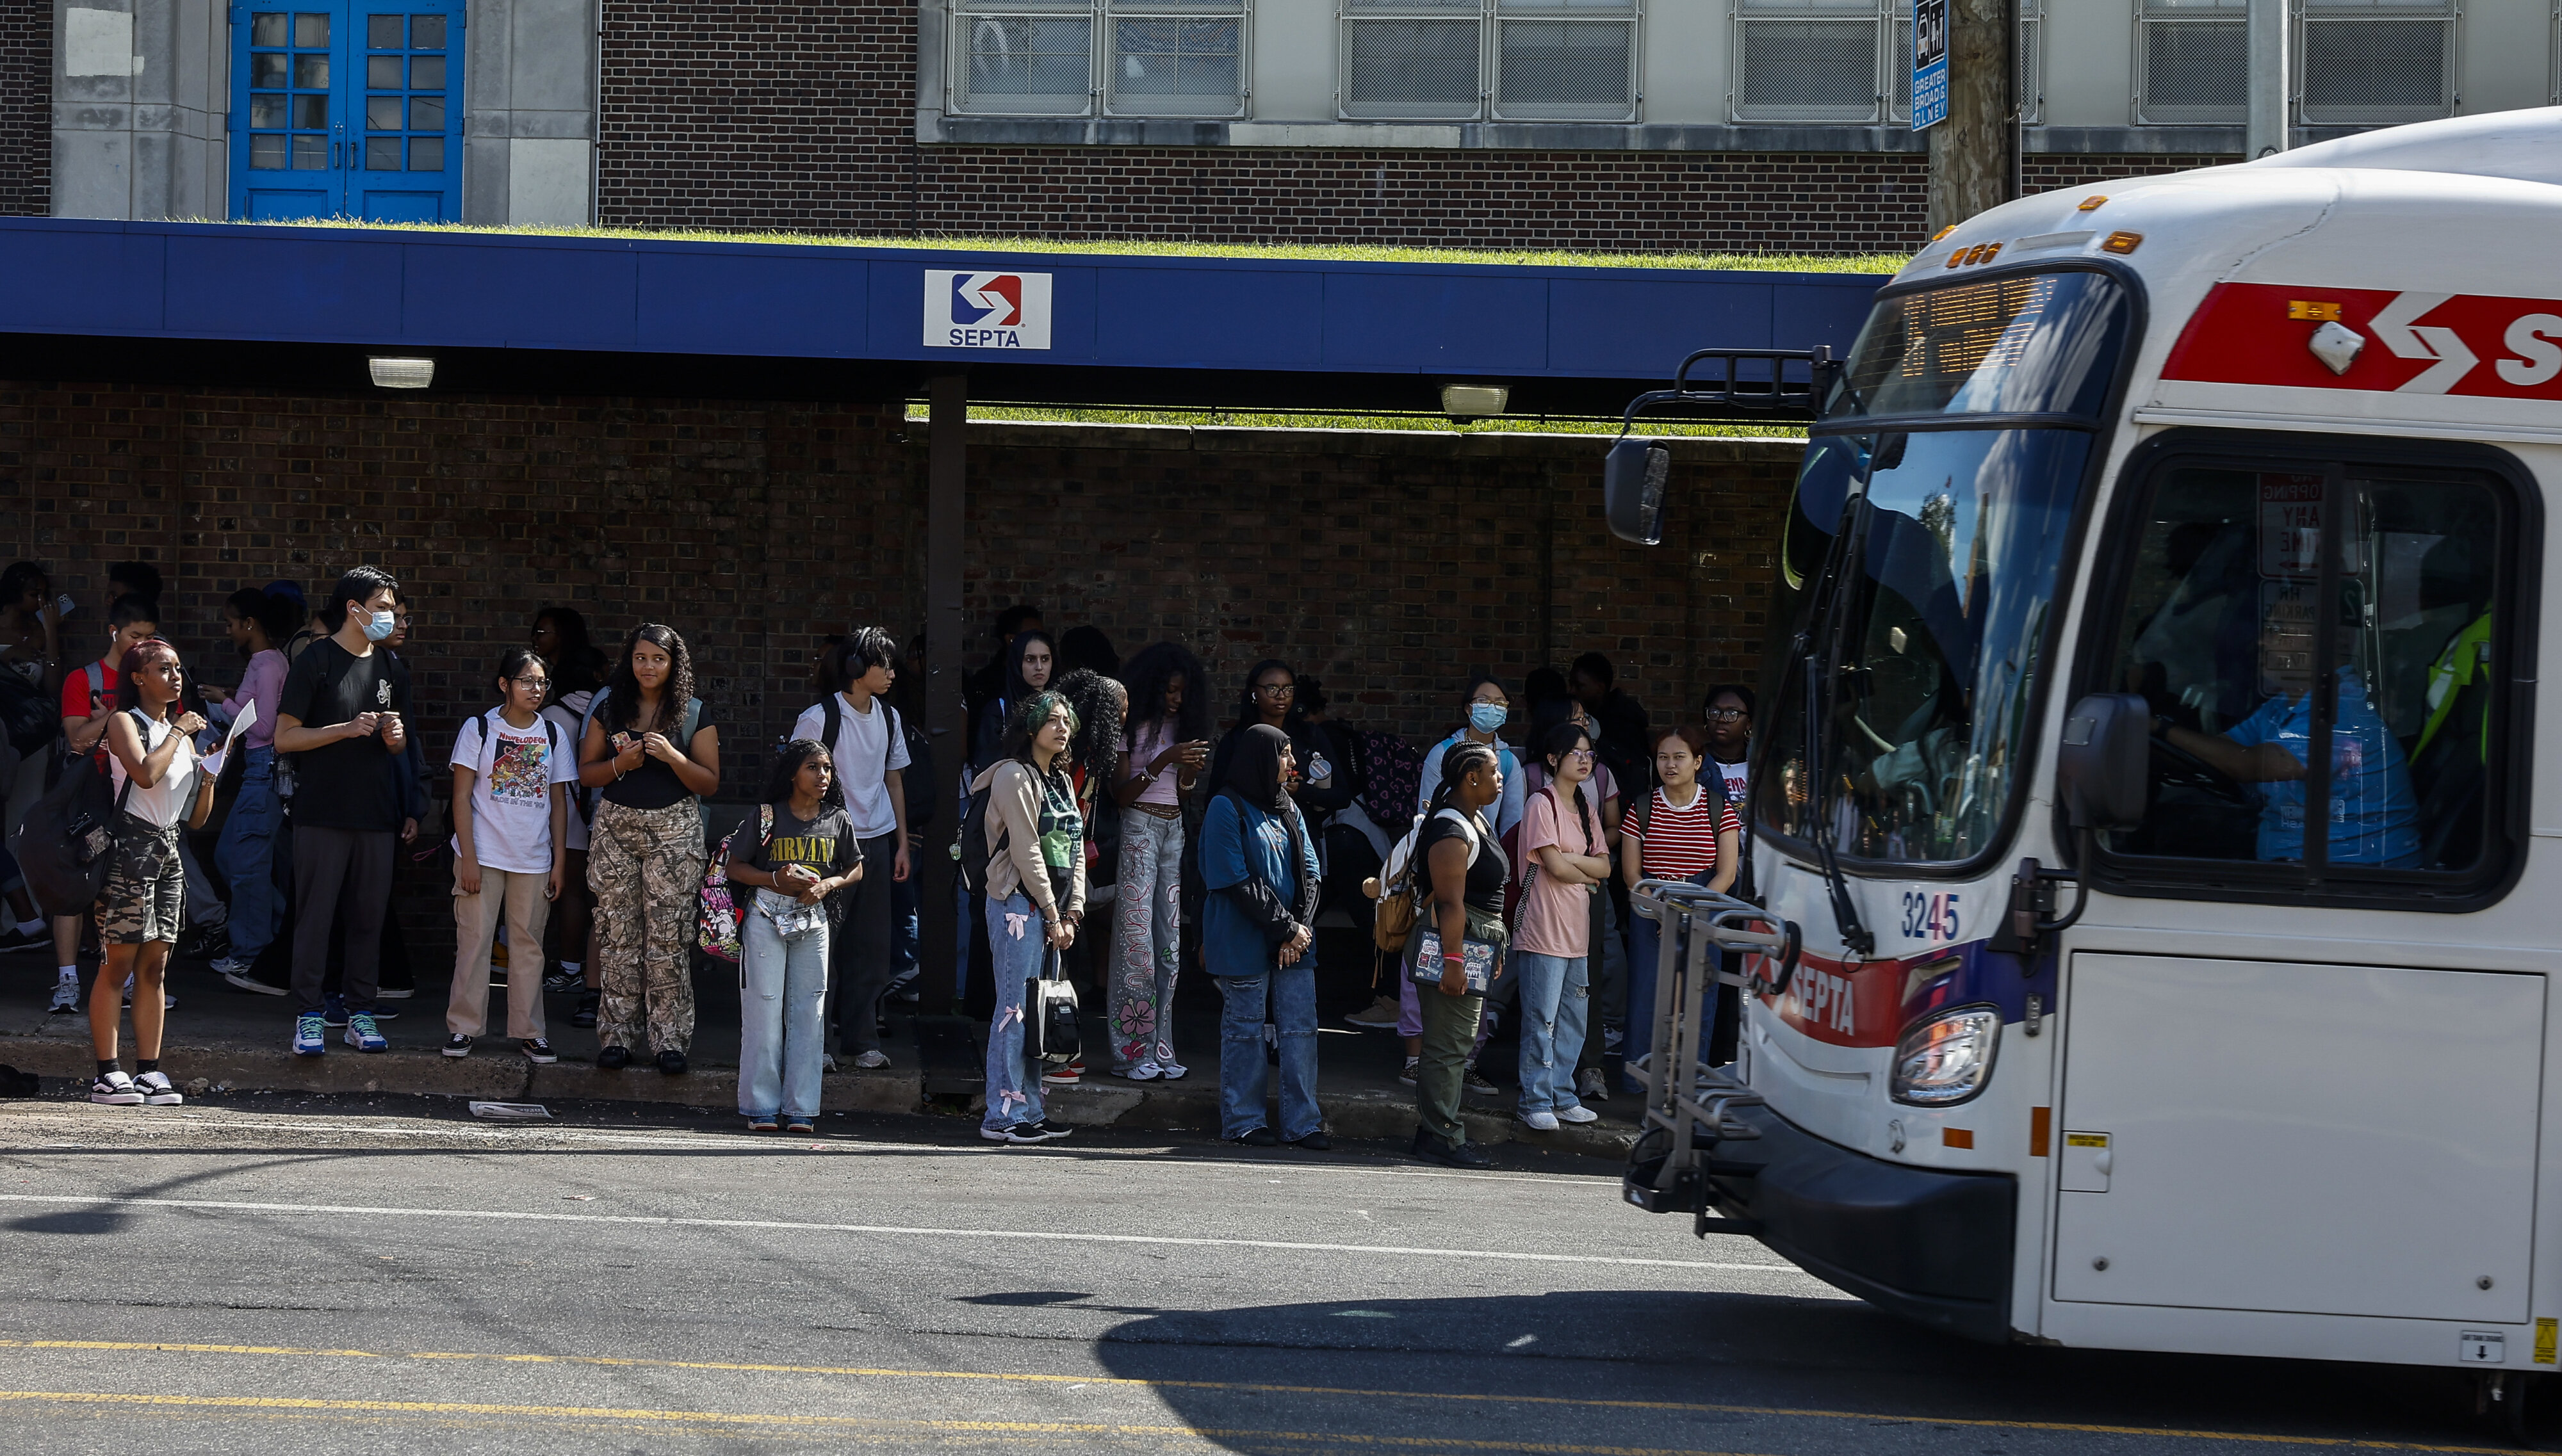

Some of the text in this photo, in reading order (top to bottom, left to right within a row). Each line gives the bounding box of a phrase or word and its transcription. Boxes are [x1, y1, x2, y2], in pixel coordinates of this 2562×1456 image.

[1914, 69, 1945, 94] GREATER
[1914, 86, 1945, 111] BROAD &
[1914, 101, 1945, 126] OLNEY
[949, 328, 1020, 347] SEPTA
[1902, 891, 1959, 941] 3245
[1790, 962, 1854, 1037] SEPTA
